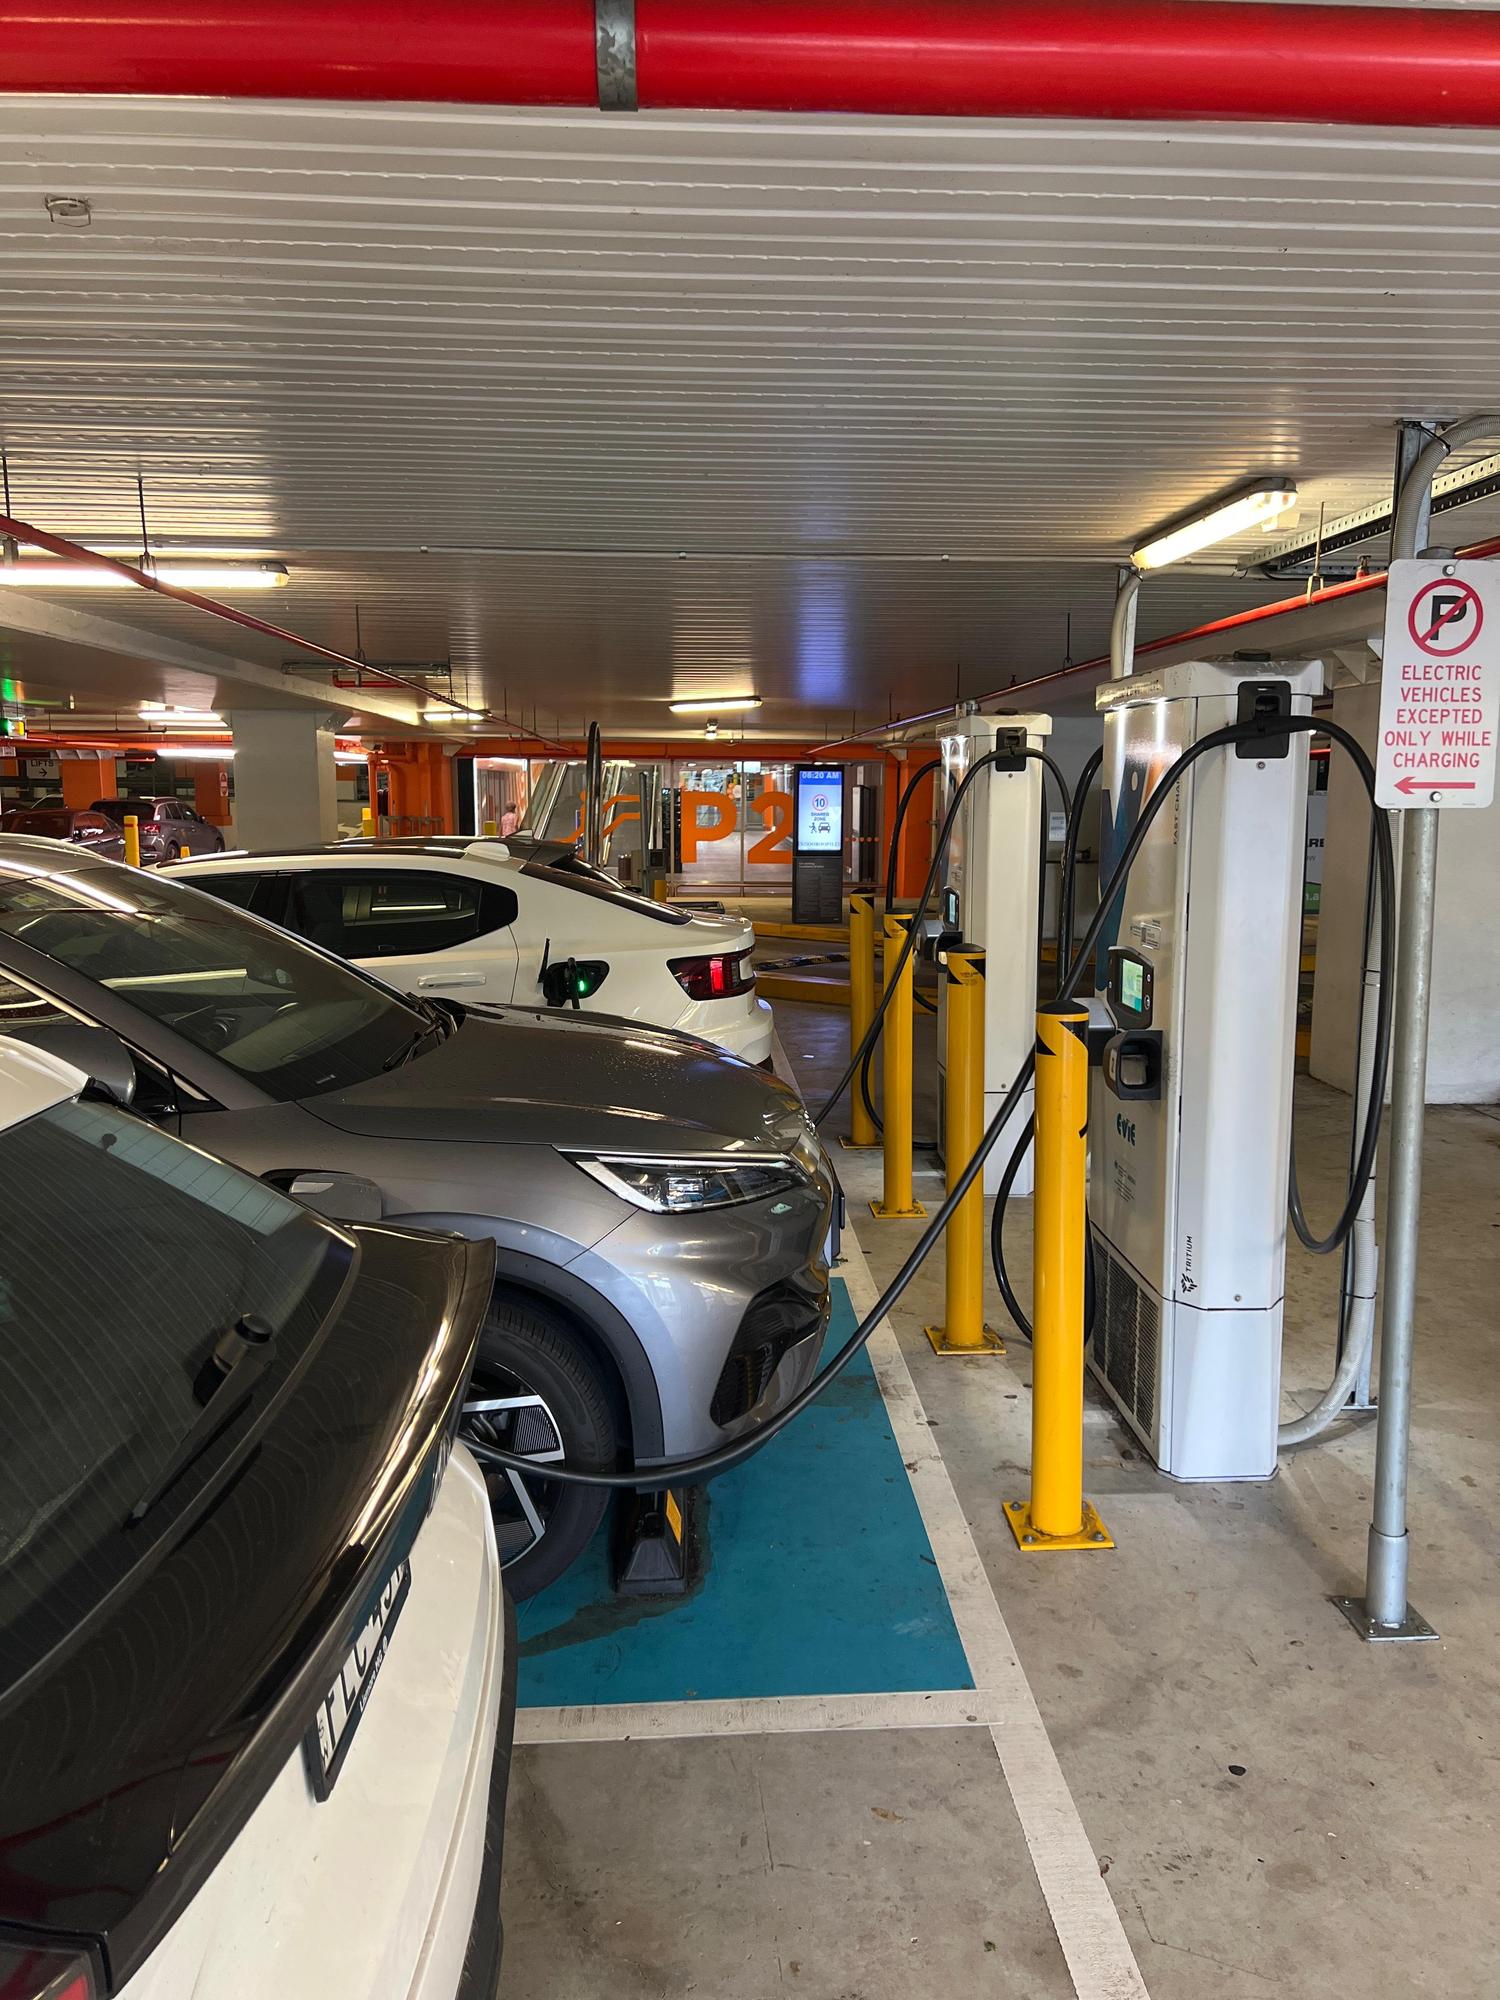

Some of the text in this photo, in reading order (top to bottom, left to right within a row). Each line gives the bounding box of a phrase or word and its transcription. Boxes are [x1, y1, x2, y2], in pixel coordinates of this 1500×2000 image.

[1430, 595, 1467, 641] P
[1401, 665, 1482, 681] ELECTRIC
[1400, 687, 1482, 703] VEHICLES
[1396, 708, 1483, 724] EXCEPTED
[1384, 730, 1492, 747] ONLY WHILE
[1393, 752, 1480, 768] CHARGING
[825, 771, 839, 779] AM
[815, 798, 825, 808] 10
[681, 791, 792, 864] P2
[1185, 1235, 1193, 1272] TRITIUM
